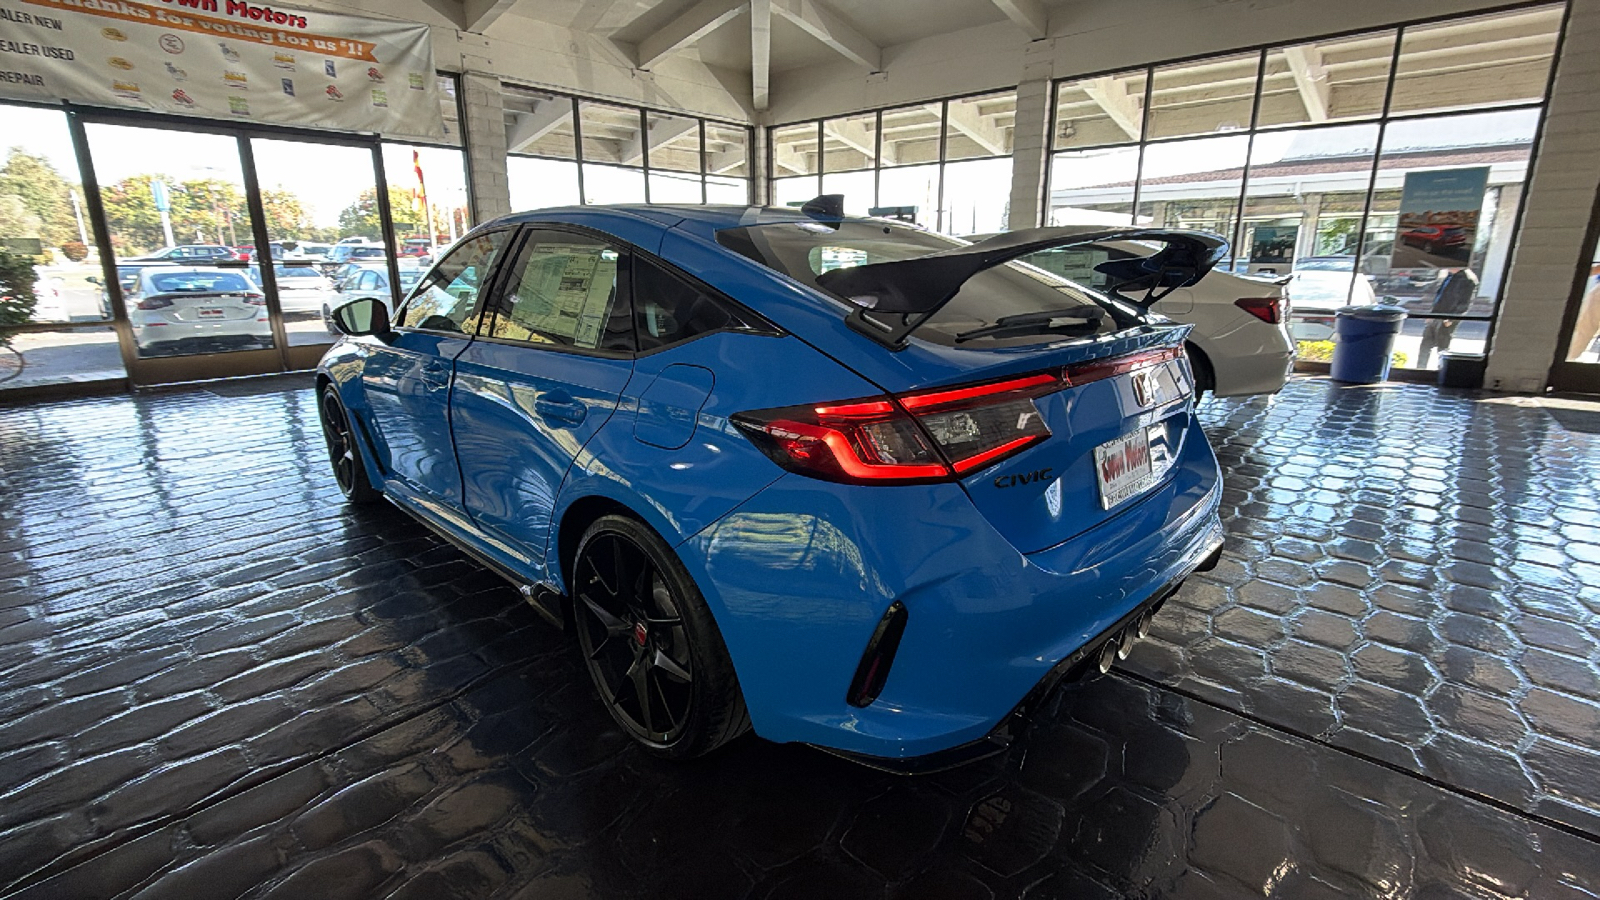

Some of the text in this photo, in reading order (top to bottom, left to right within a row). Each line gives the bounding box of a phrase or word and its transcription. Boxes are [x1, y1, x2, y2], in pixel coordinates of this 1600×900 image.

[0, 8, 62, 30] ALER NEW
[162, 0, 308, 29] wn Motors
[49, 0, 151, 19] anks
[156, 10, 194, 26] for
[200, 20, 274, 43] voting
[277, 31, 310, 47] for
[314, 39, 338, 51] us
[0, 40, 75, 60] EALER USED
[0, 71, 45, 86] REPAIR
[994, 467, 1053, 488] CIVIC
